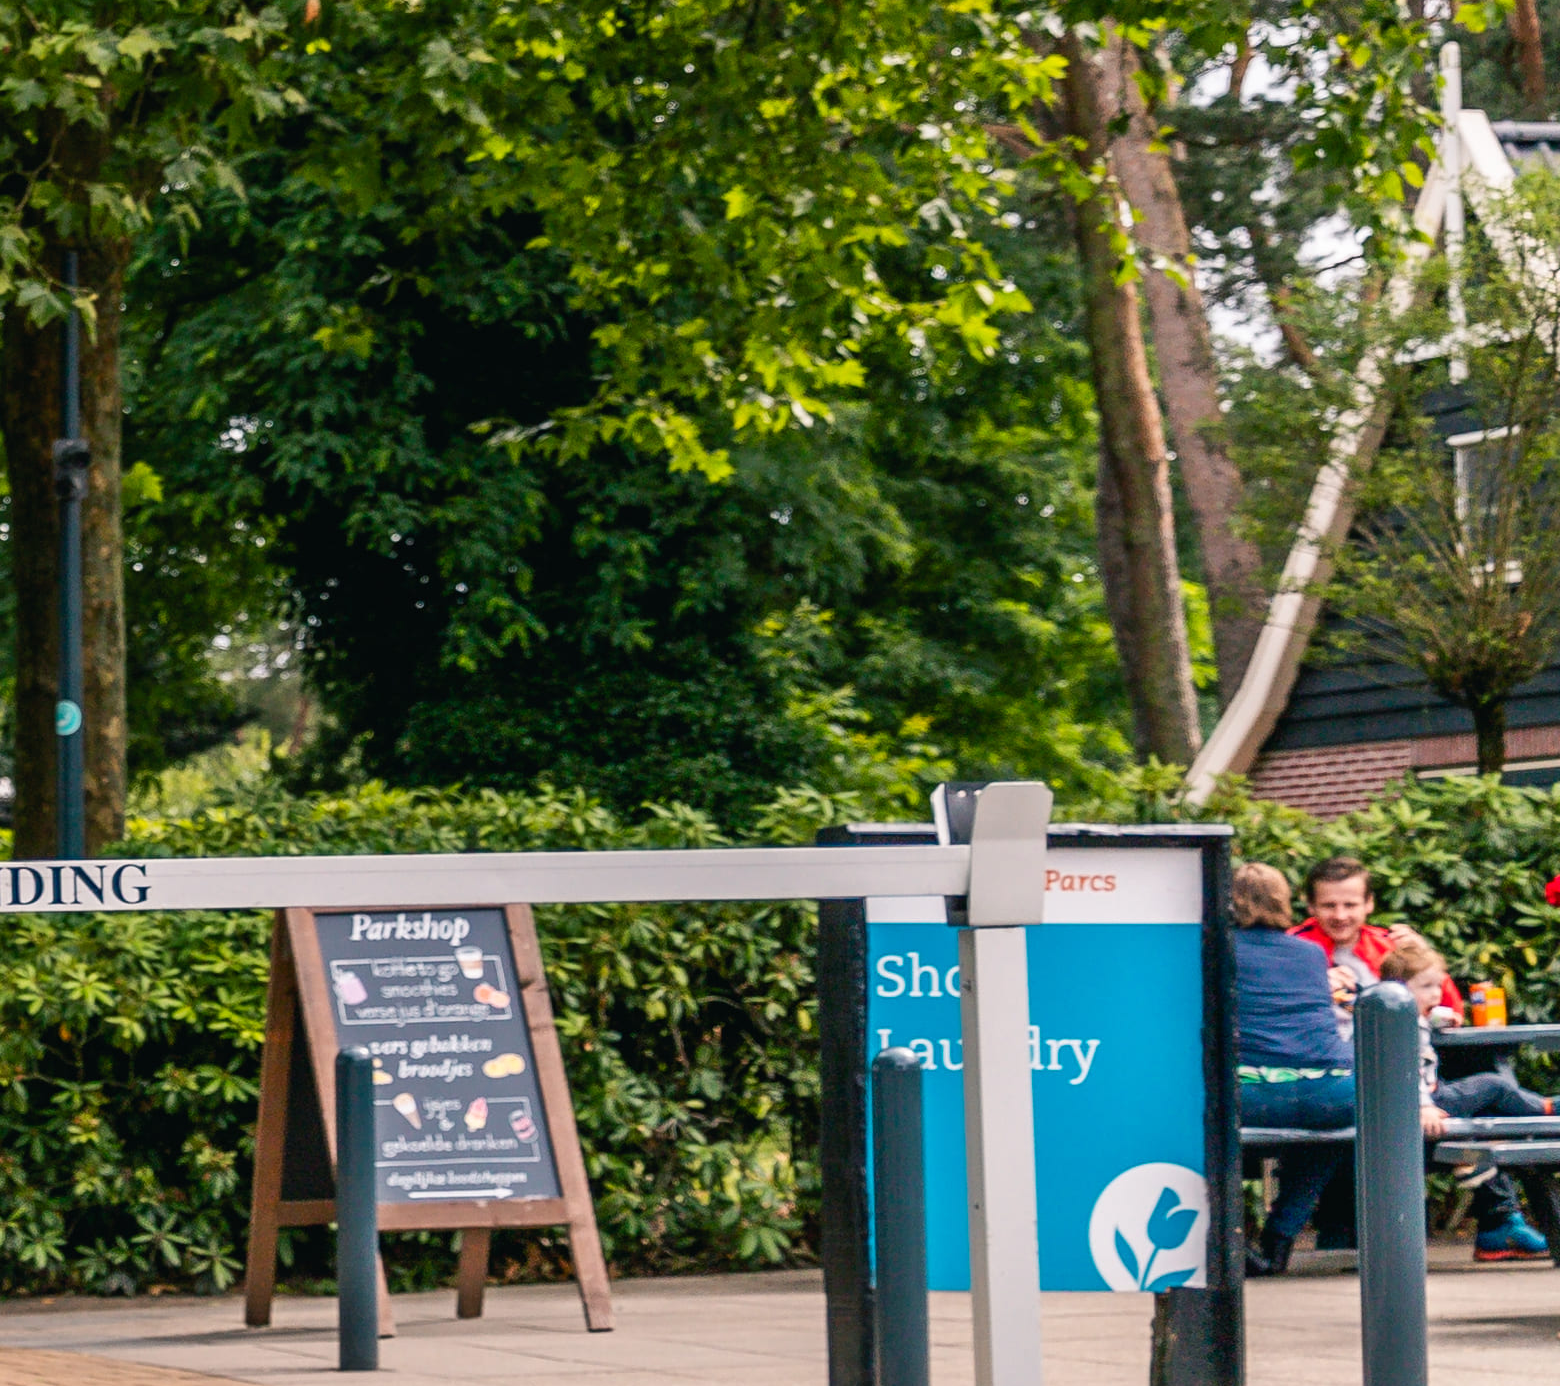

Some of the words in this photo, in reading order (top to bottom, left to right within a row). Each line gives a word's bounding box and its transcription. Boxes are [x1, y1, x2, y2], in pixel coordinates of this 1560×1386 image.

[348, 912, 470, 946] Parkshop
[437, 963, 459, 982] go
[379, 979, 459, 998] smoothies
[368, 1040, 408, 1055] vers
[409, 1034, 493, 1059] gebakken
[397, 1059, 473, 1083] broodjes
